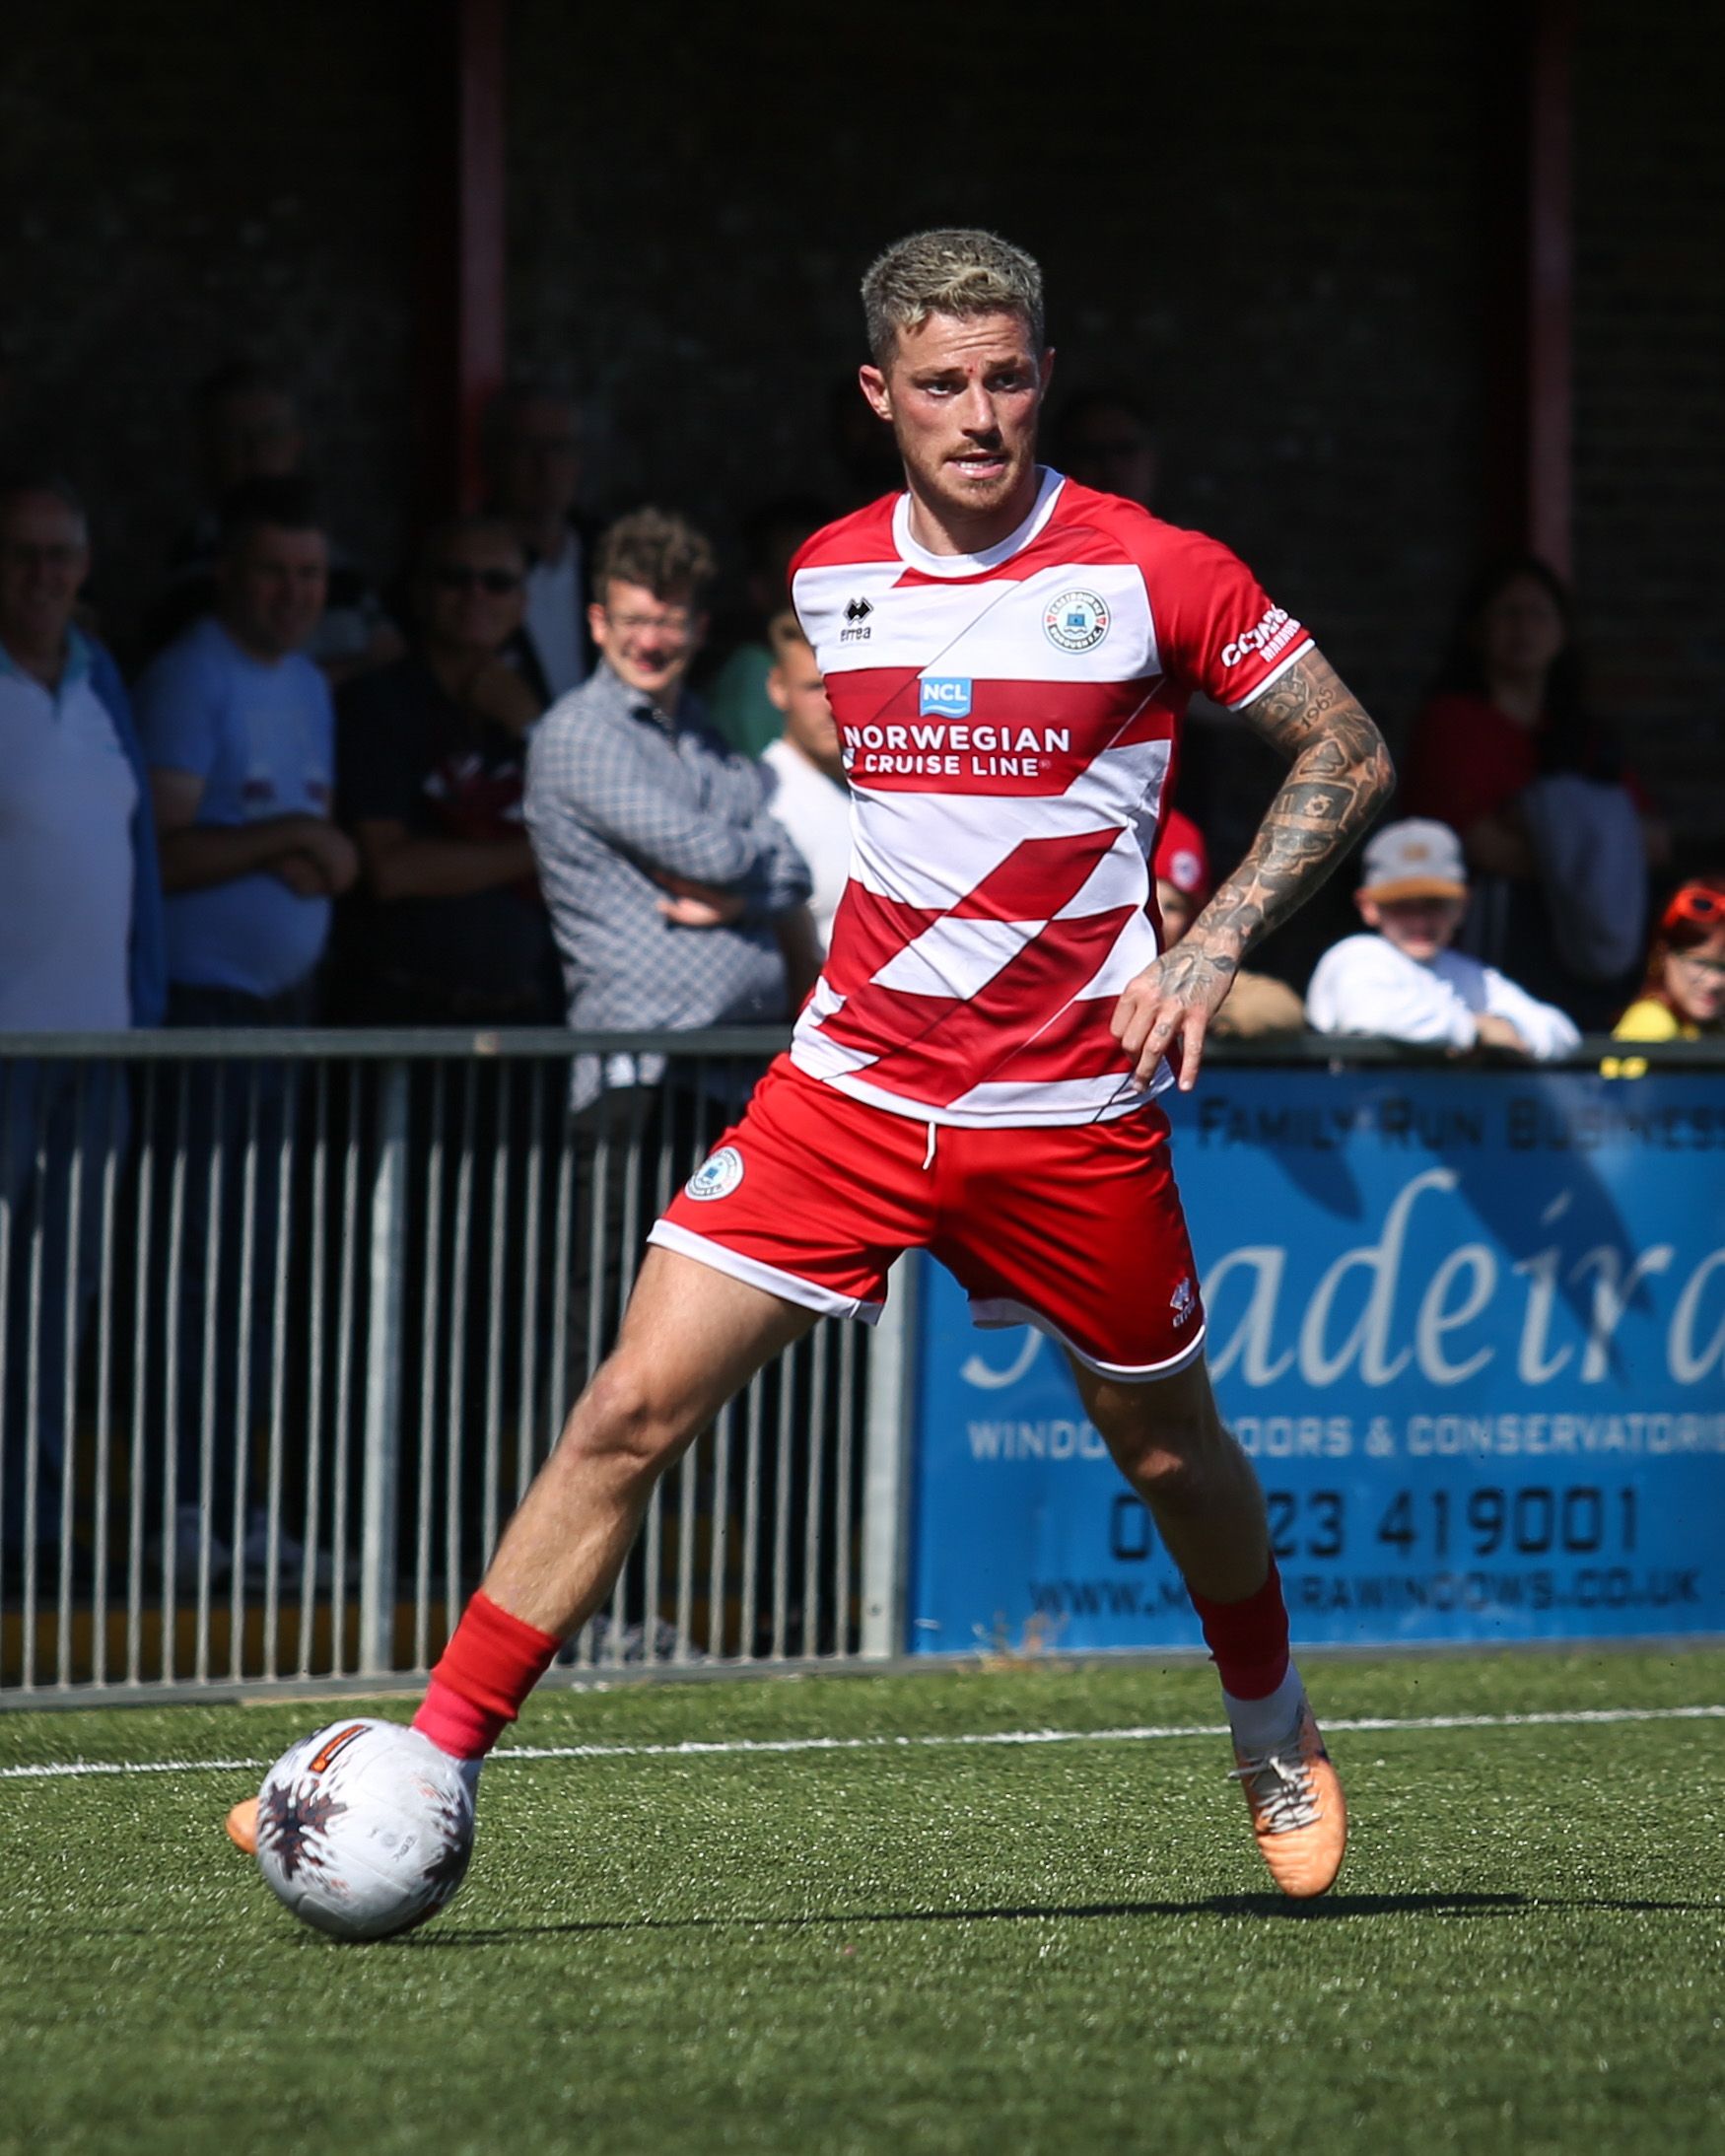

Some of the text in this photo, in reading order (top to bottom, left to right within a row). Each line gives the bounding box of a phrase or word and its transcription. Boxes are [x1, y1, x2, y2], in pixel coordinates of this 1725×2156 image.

[923, 683, 968, 701] NCL
[1300, 687, 1334, 730] 1965
[843, 725, 1070, 752] NORWEGIAN
[864, 754, 960, 775] CRUISE
[967, 1420, 1109, 1459] WINDO
[1232, 1417, 1352, 1459] OORS
[1364, 1417, 1395, 1458] &
[1110, 1486, 1636, 1560] 023 419001
